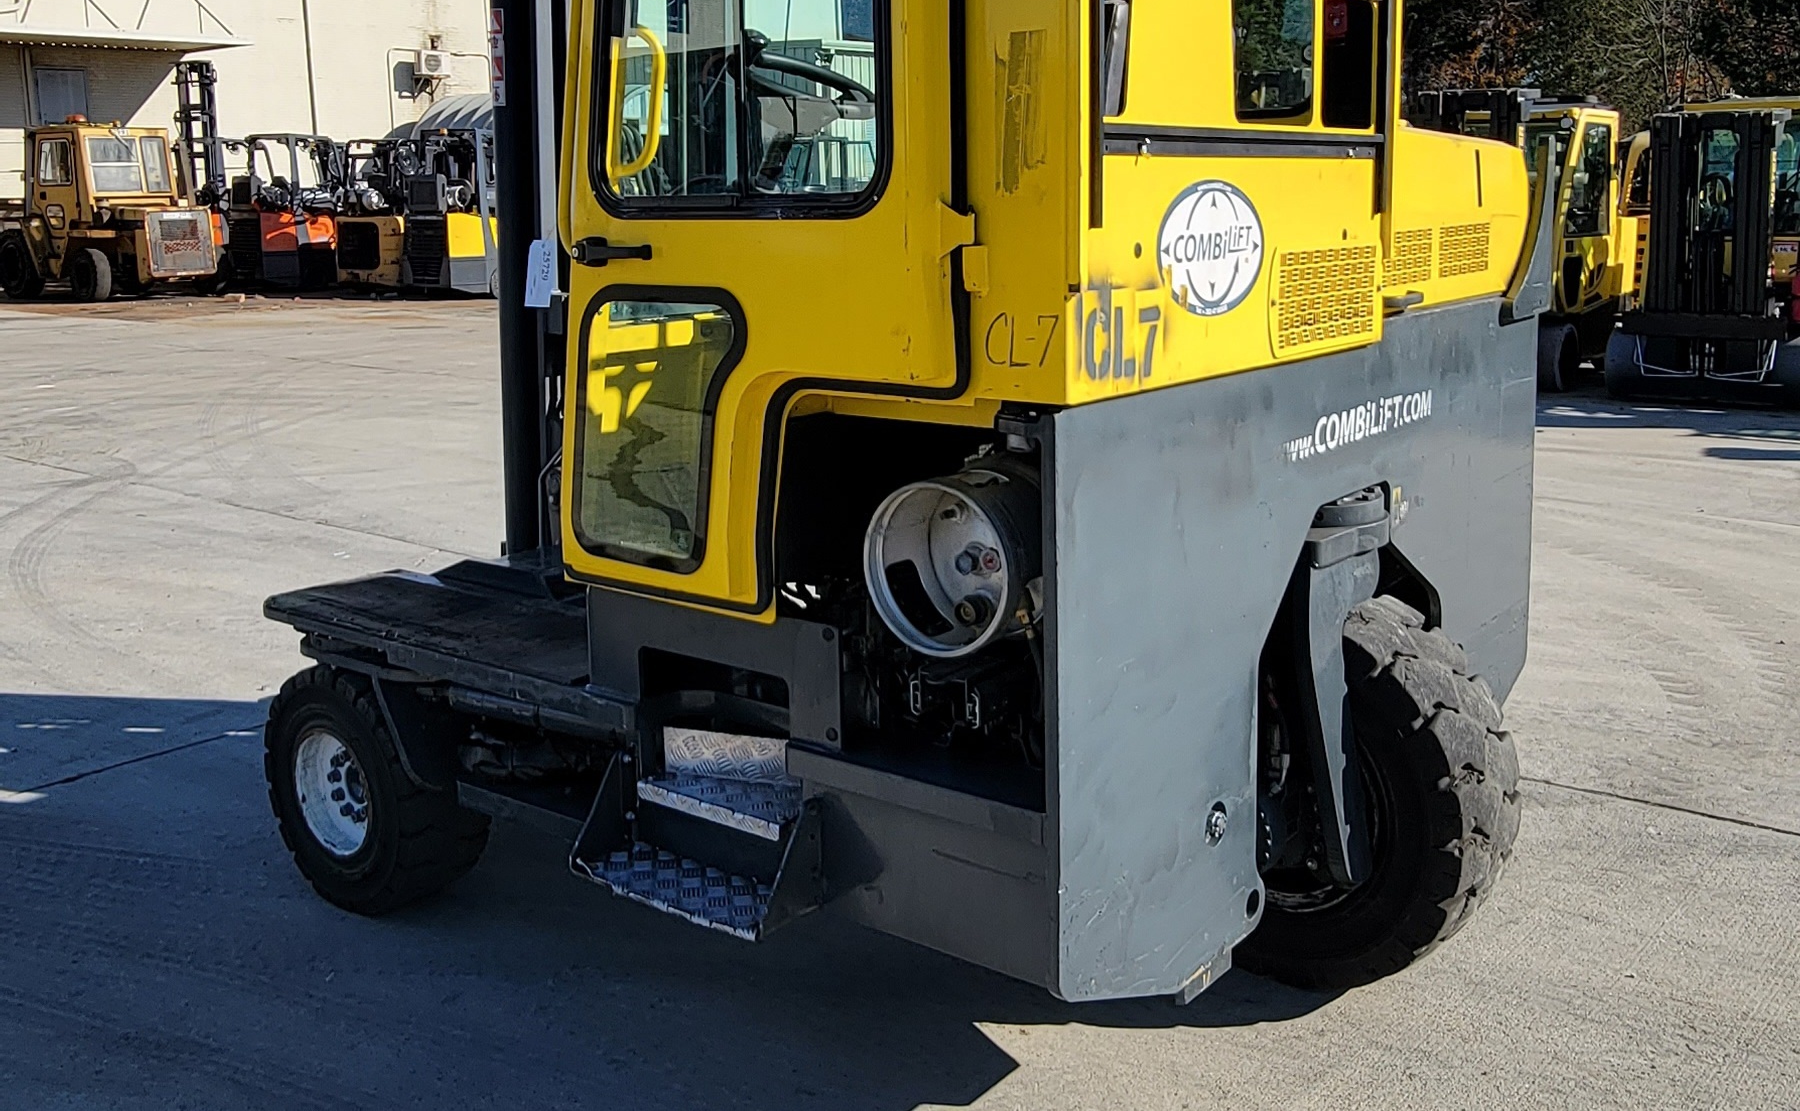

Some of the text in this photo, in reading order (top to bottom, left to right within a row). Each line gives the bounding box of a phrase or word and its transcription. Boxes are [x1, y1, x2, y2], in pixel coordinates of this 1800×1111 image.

[541, 250, 551, 281] 25729
[985, 311, 1059, 368] CL-7
[1085, 305, 1161, 381] CL7
